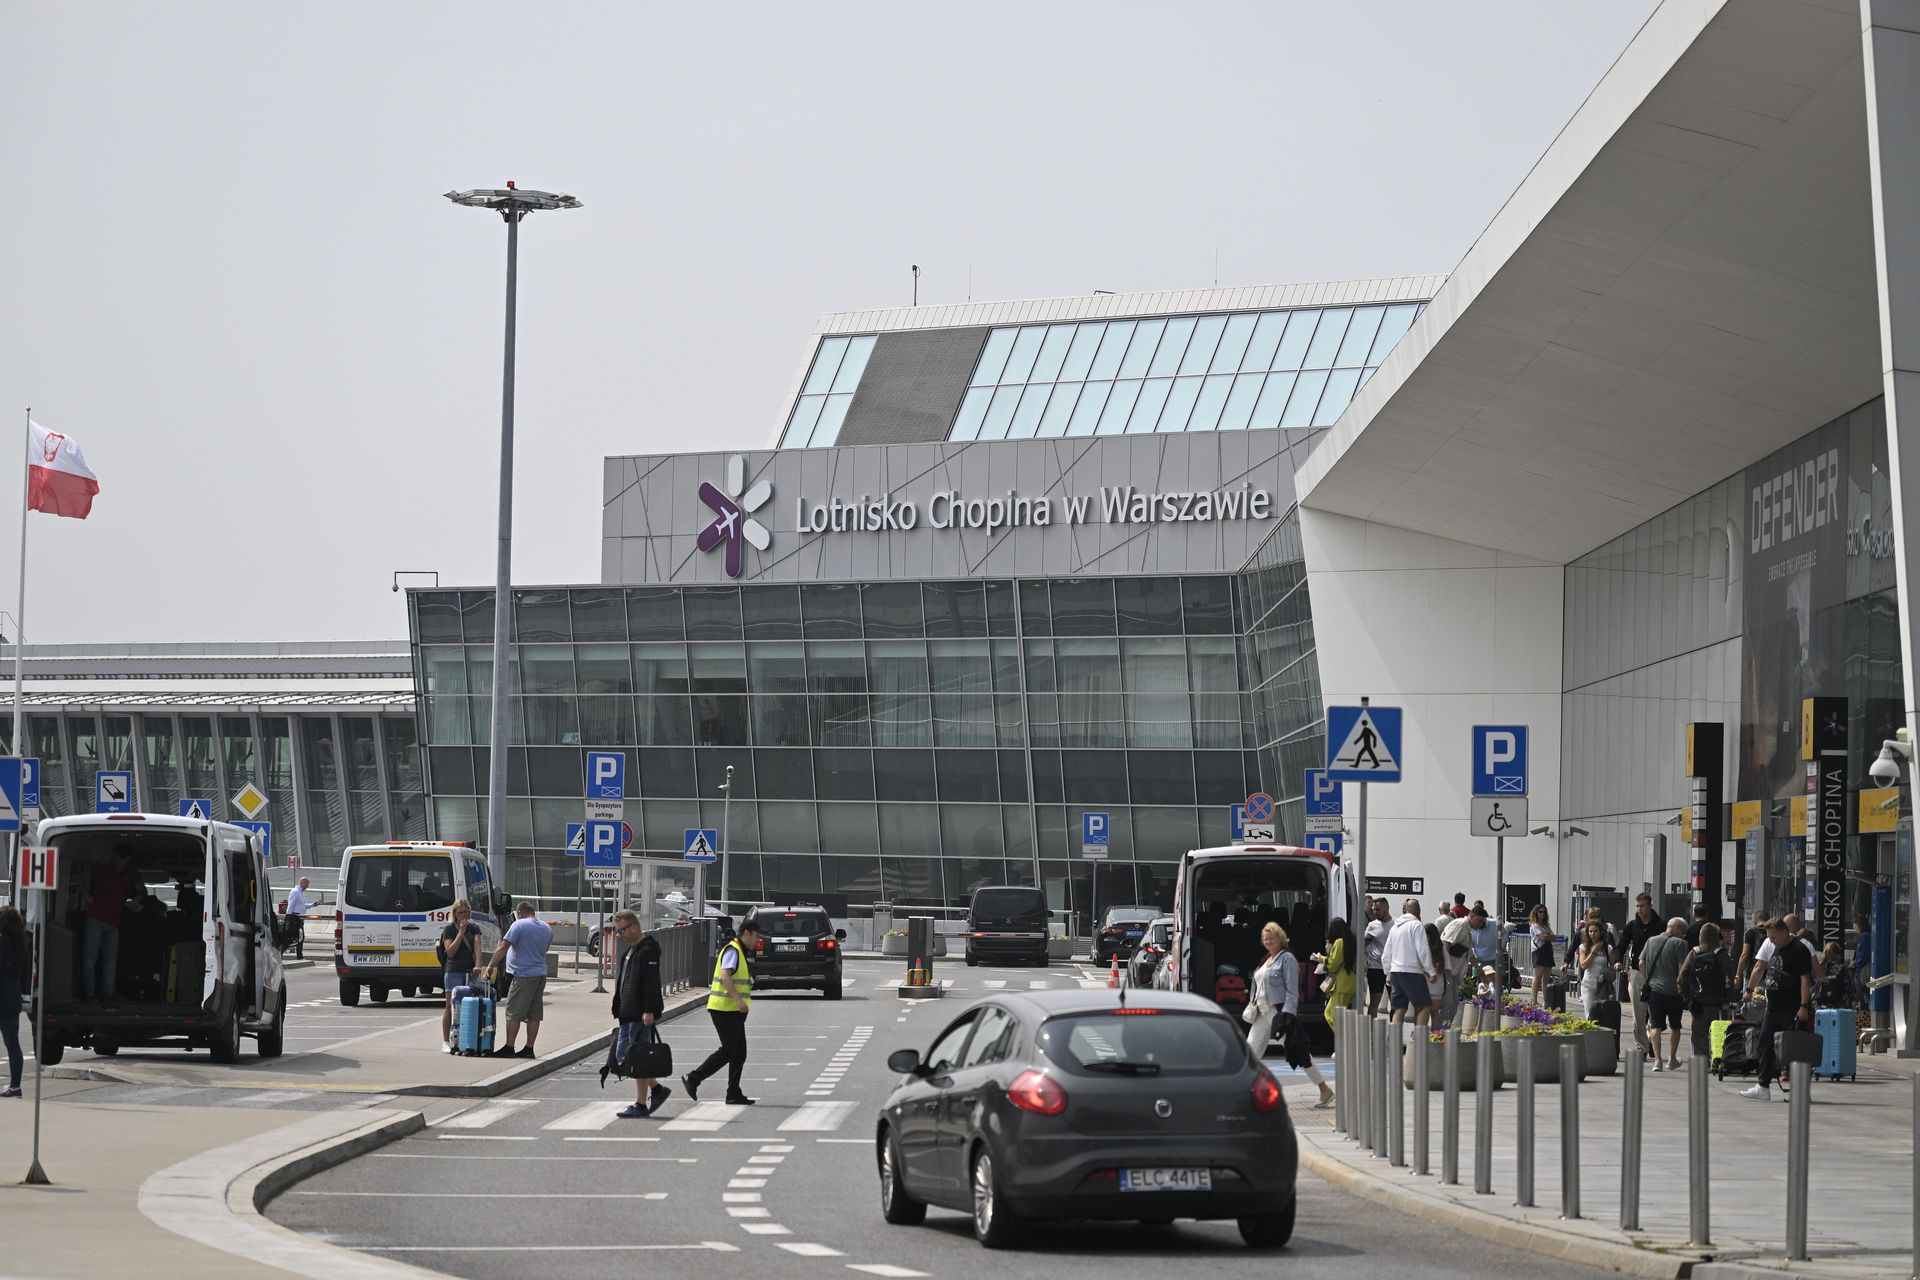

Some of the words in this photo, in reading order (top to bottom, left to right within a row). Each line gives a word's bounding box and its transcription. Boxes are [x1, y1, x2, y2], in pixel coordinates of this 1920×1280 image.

[796, 493, 919, 534] Lotnisko
[928, 489, 1055, 537] Chopina
[1063, 495, 1093, 525] w
[1100, 481, 1271, 525] Warszawie
[1752, 448, 1839, 555] DEFENDER
[1485, 731, 1516, 775] P
[595, 756, 617, 786] P
[1313, 772, 1335, 802] P
[1089, 815, 1104, 836] P
[1824, 769, 1842, 866] CHOPINA
[593, 824, 615, 854] P
[31, 852, 46, 884] H
[588, 870, 617, 879] Koniec
[1389, 881, 1399, 891] 30
[1400, 883, 1407, 891] m
[1823, 880, 1841, 947] NISKO
[1130, 1169, 1165, 1186] ELC
